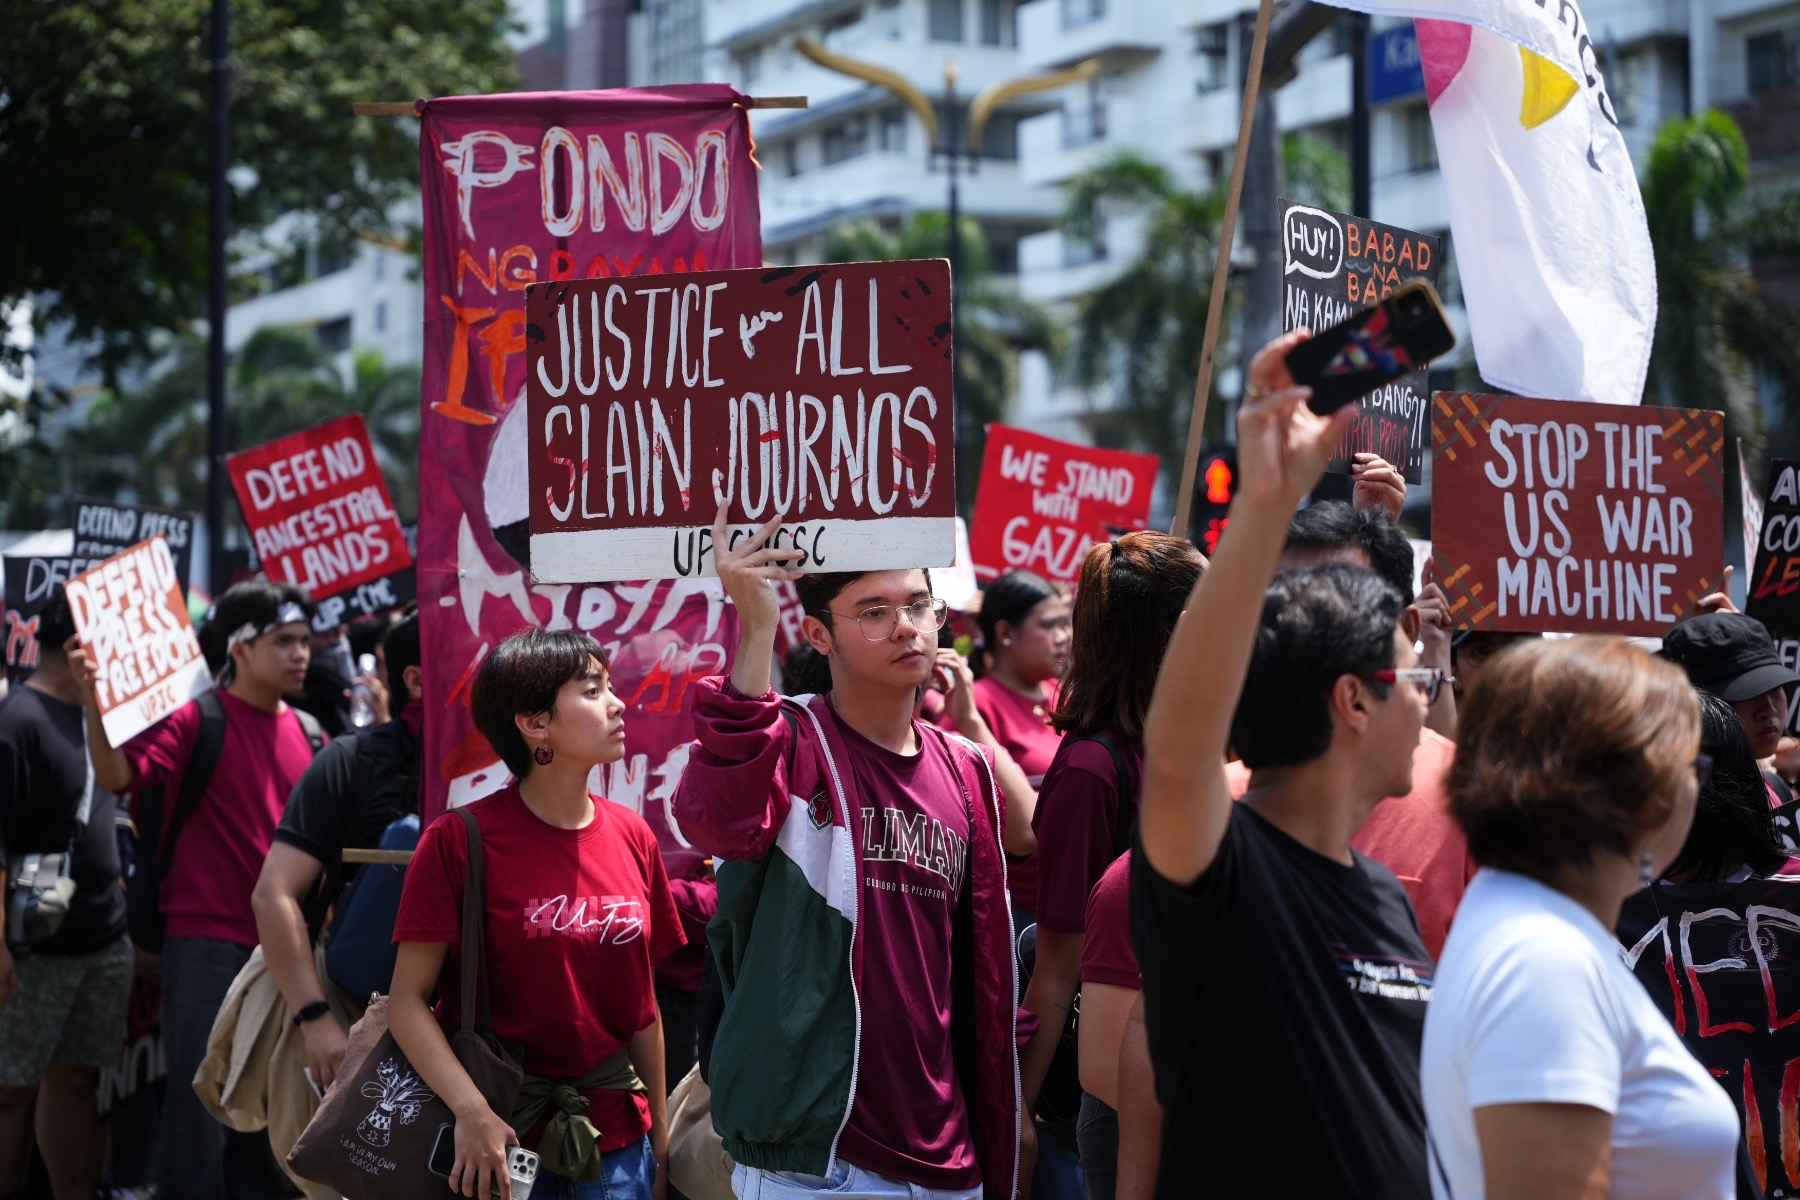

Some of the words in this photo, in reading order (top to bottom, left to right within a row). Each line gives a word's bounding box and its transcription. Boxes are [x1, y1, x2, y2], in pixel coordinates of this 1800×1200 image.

[440, 126, 731, 241] PONDO
[458, 245, 538, 296] NG
[1291, 217, 1334, 261] HUY!
[1347, 223, 1431, 271] BABAD
[1373, 262, 1401, 286] NA
[537, 282, 728, 398] JUSTICE
[738, 309, 784, 360] for
[795, 277, 913, 377] ALL
[1285, 283, 1309, 332] NA
[1312, 292, 1354, 336] KAM
[244, 436, 366, 511] DEFEND
[544, 397, 692, 523] SLAIN
[711, 386, 938, 520] JOURNOS
[1000, 444, 1049, 486] WE
[1056, 459, 1135, 506] STAND
[1484, 418, 1589, 490] STOP
[1595, 422, 1667, 493] THE
[77, 505, 138, 541] DEFEND
[254, 484, 395, 561] ANCESTRAL
[1032, 489, 1079, 523] WITH
[1504, 489, 1572, 558] US
[1597, 495, 1693, 557] WAR
[66, 536, 177, 645] DEFEND
[280, 523, 390, 592] LANDS
[1497, 555, 1678, 623] MACHINE
[91, 588, 182, 681] PRESS
[94, 623, 202, 710] FREEDOM
[377, 1157, 397, 1171] OWN
